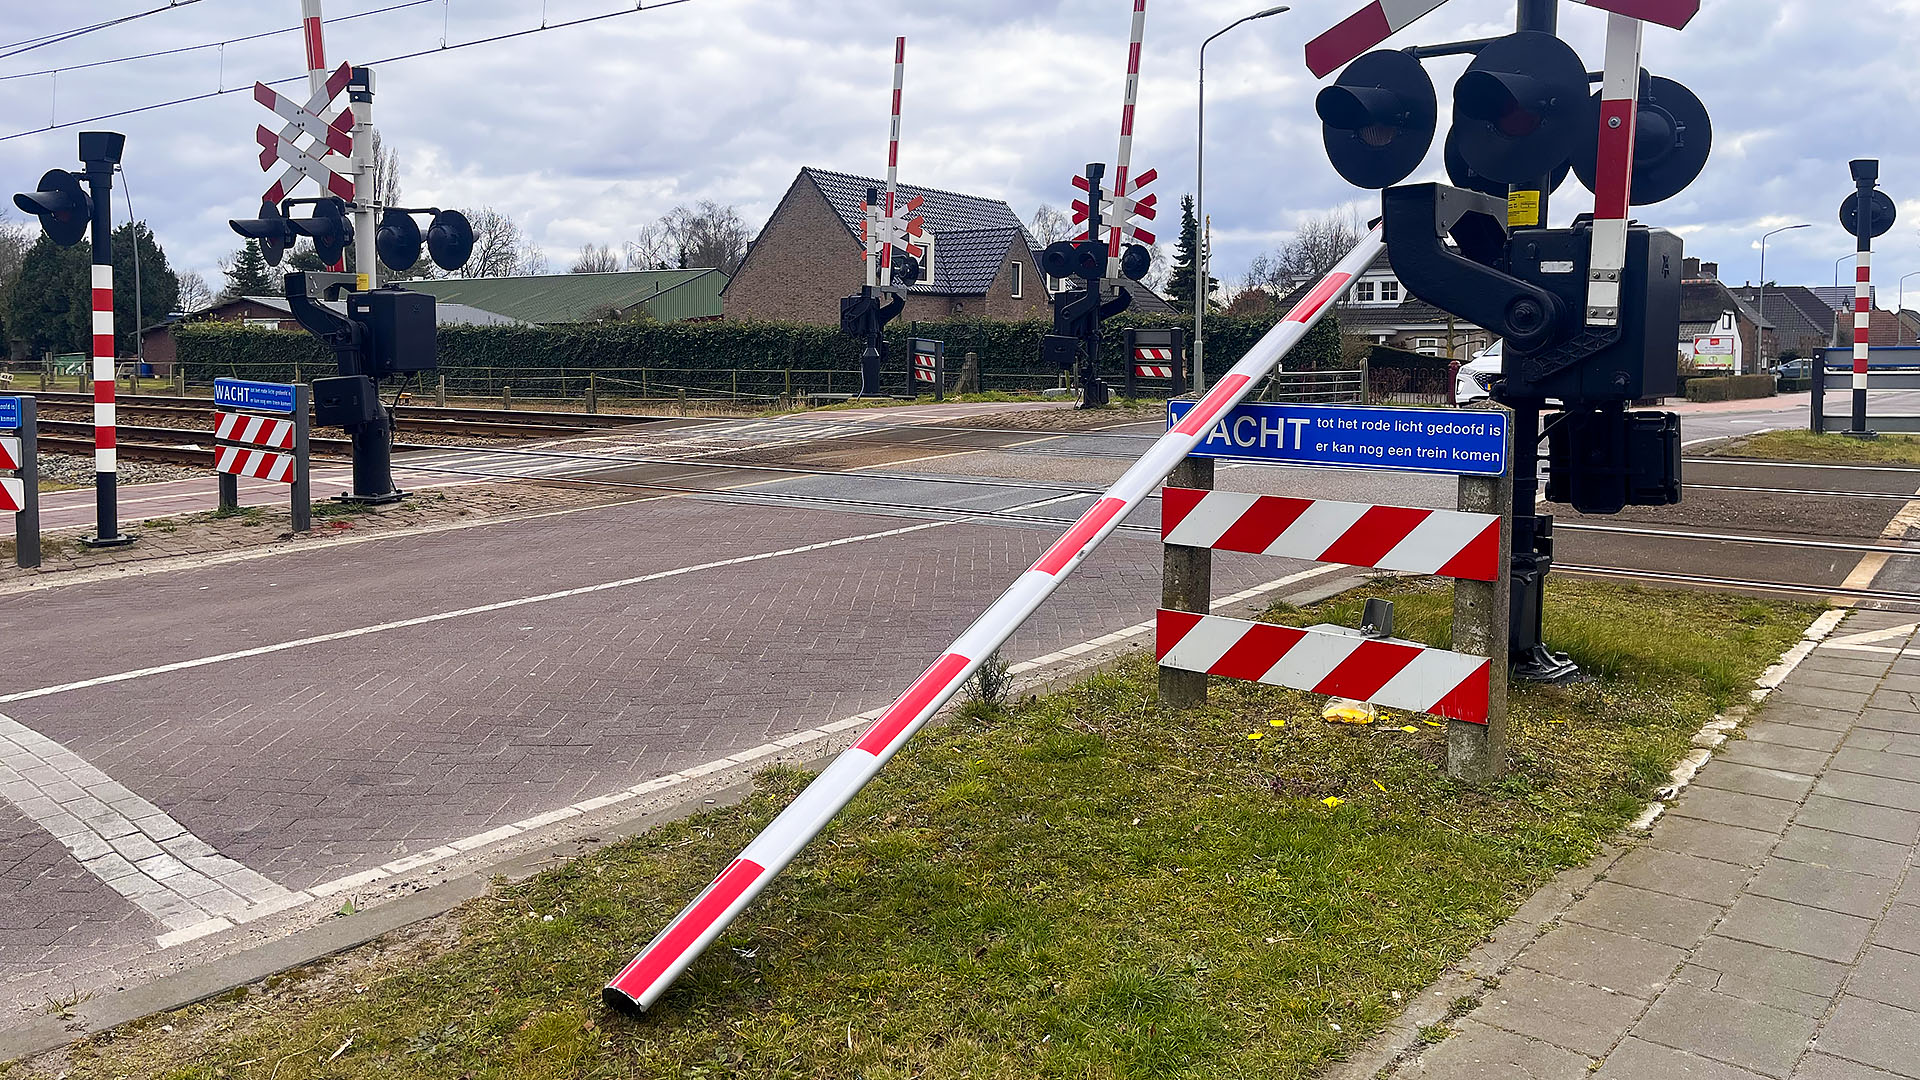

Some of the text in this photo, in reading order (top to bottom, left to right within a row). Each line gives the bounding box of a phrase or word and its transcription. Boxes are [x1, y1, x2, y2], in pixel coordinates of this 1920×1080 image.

[215, 385, 249, 402] WACHT
[1171, 412, 1311, 450] ACHT
[1317, 417, 1501, 436] tot het rode licht gedoofd is
[1315, 441, 1500, 462] er kan nog een trein komen
